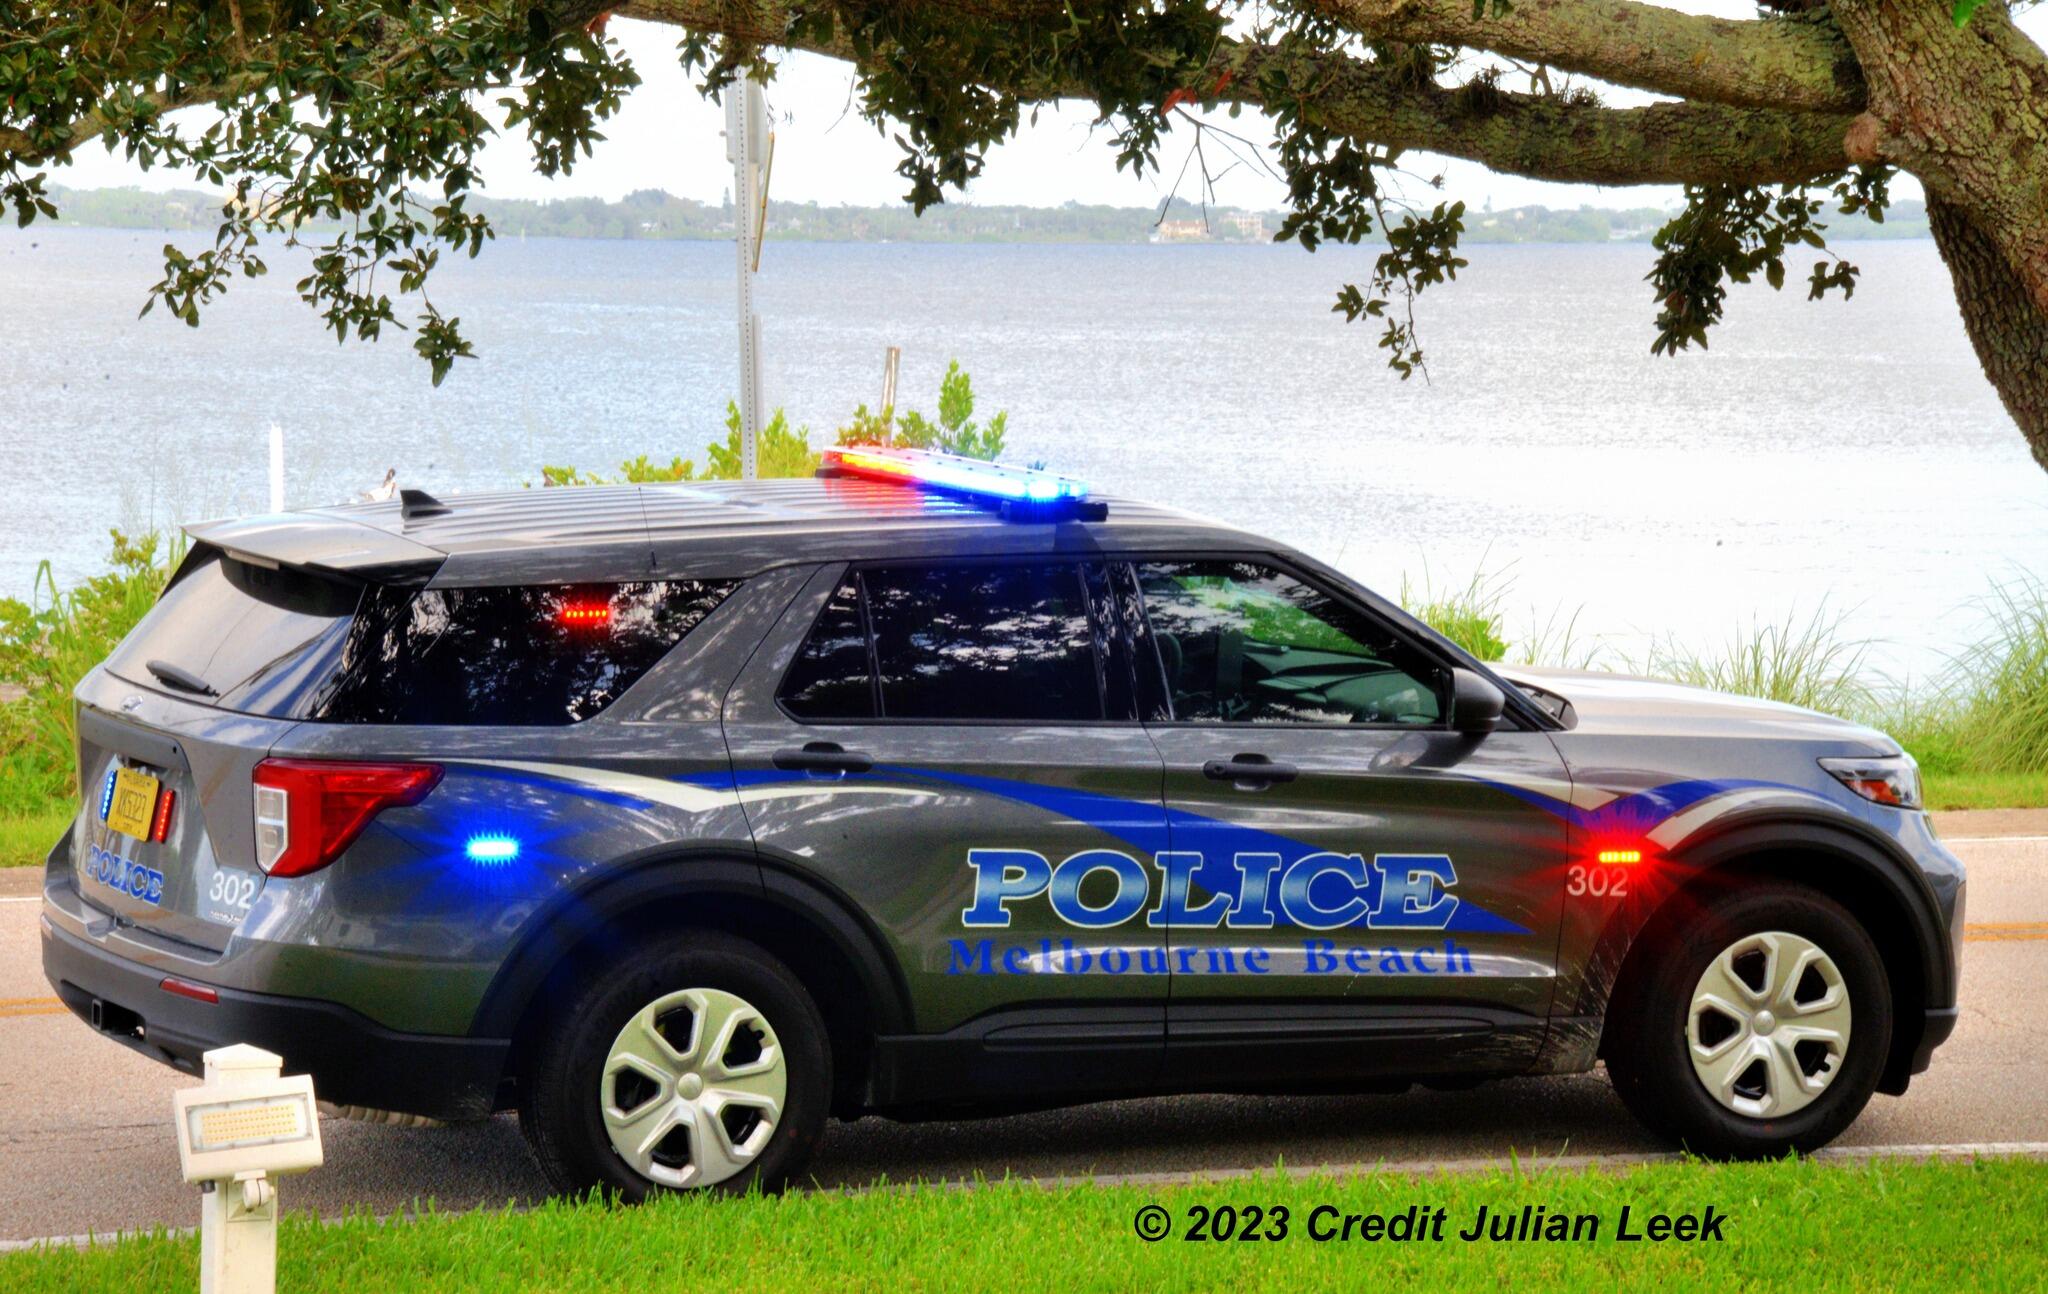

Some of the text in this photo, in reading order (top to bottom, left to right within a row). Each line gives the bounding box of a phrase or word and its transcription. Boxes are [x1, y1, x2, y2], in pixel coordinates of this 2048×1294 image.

[86, 844, 164, 906] POLICE
[209, 870, 255, 910] 302
[962, 848, 1460, 930] POLICE
[1567, 865, 1628, 897] 302
[947, 937, 1476, 975] Melbourne Beach
